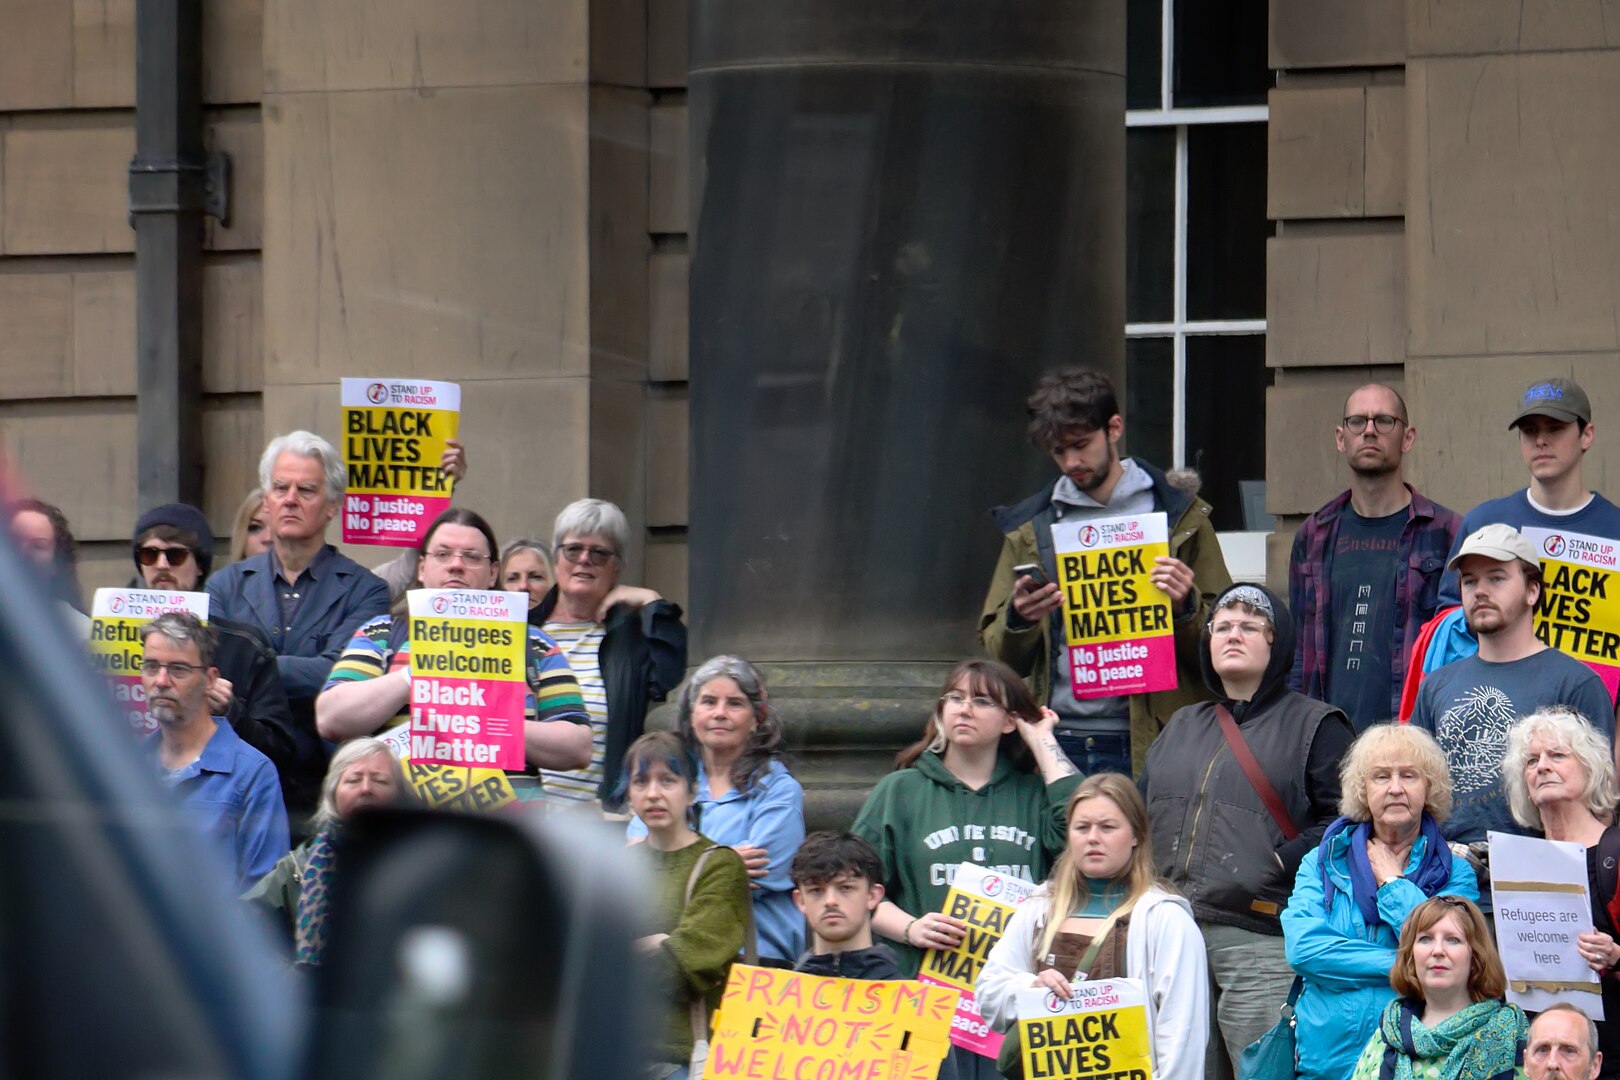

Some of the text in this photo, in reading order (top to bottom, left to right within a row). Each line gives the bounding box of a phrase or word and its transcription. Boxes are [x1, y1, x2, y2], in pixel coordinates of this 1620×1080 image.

[391, 384, 433, 396] STAND UP
[391, 395, 437, 405] TO RACISM
[348, 410, 432, 437] BLACK
[348, 437, 421, 463] LIVES
[348, 464, 448, 491] MATTER
[347, 497, 425, 516] No justice
[347, 514, 417, 533] No peace
[1102, 521, 1139, 534] STAND UP
[1102, 531, 1145, 544] TO RACISM
[1569, 539, 1614, 555] STAND UP
[1064, 549, 1146, 582] BLACK
[1568, 549, 1617, 566] TO RACISM
[1540, 562, 1611, 600] LACK
[129, 593, 186, 605] STAND UP
[453, 593, 505, 606] STAND UP
[1067, 579, 1138, 610] LIVES
[129, 605, 143, 615] TO
[453, 605, 509, 618] TO RACISM
[1537, 593, 1592, 625] VES
[1070, 604, 1169, 639] MATTER
[413, 620, 512, 649] Refugees
[415, 651, 512, 675] welcome
[1073, 643, 1148, 666] No justice
[1075, 665, 1143, 685] No peace
[413, 680, 487, 706] Black
[412, 708, 481, 735] Lives
[411, 735, 501, 763] Matter
[950, 893, 1015, 932] BLA
[1501, 908, 1578, 924] Refugees are
[1517, 930, 1569, 943] welcome
[1534, 952, 1561, 964] here
[746, 969, 929, 1017] RACISM
[1100, 985, 1113, 996] UP
[1070, 995, 1119, 1010] TO RACISM
[781, 1013, 874, 1049] NOT
[951, 1015, 989, 1037] eace
[1027, 1013, 1120, 1049] BLACK
[1030, 1044, 1111, 1079] LIVES
